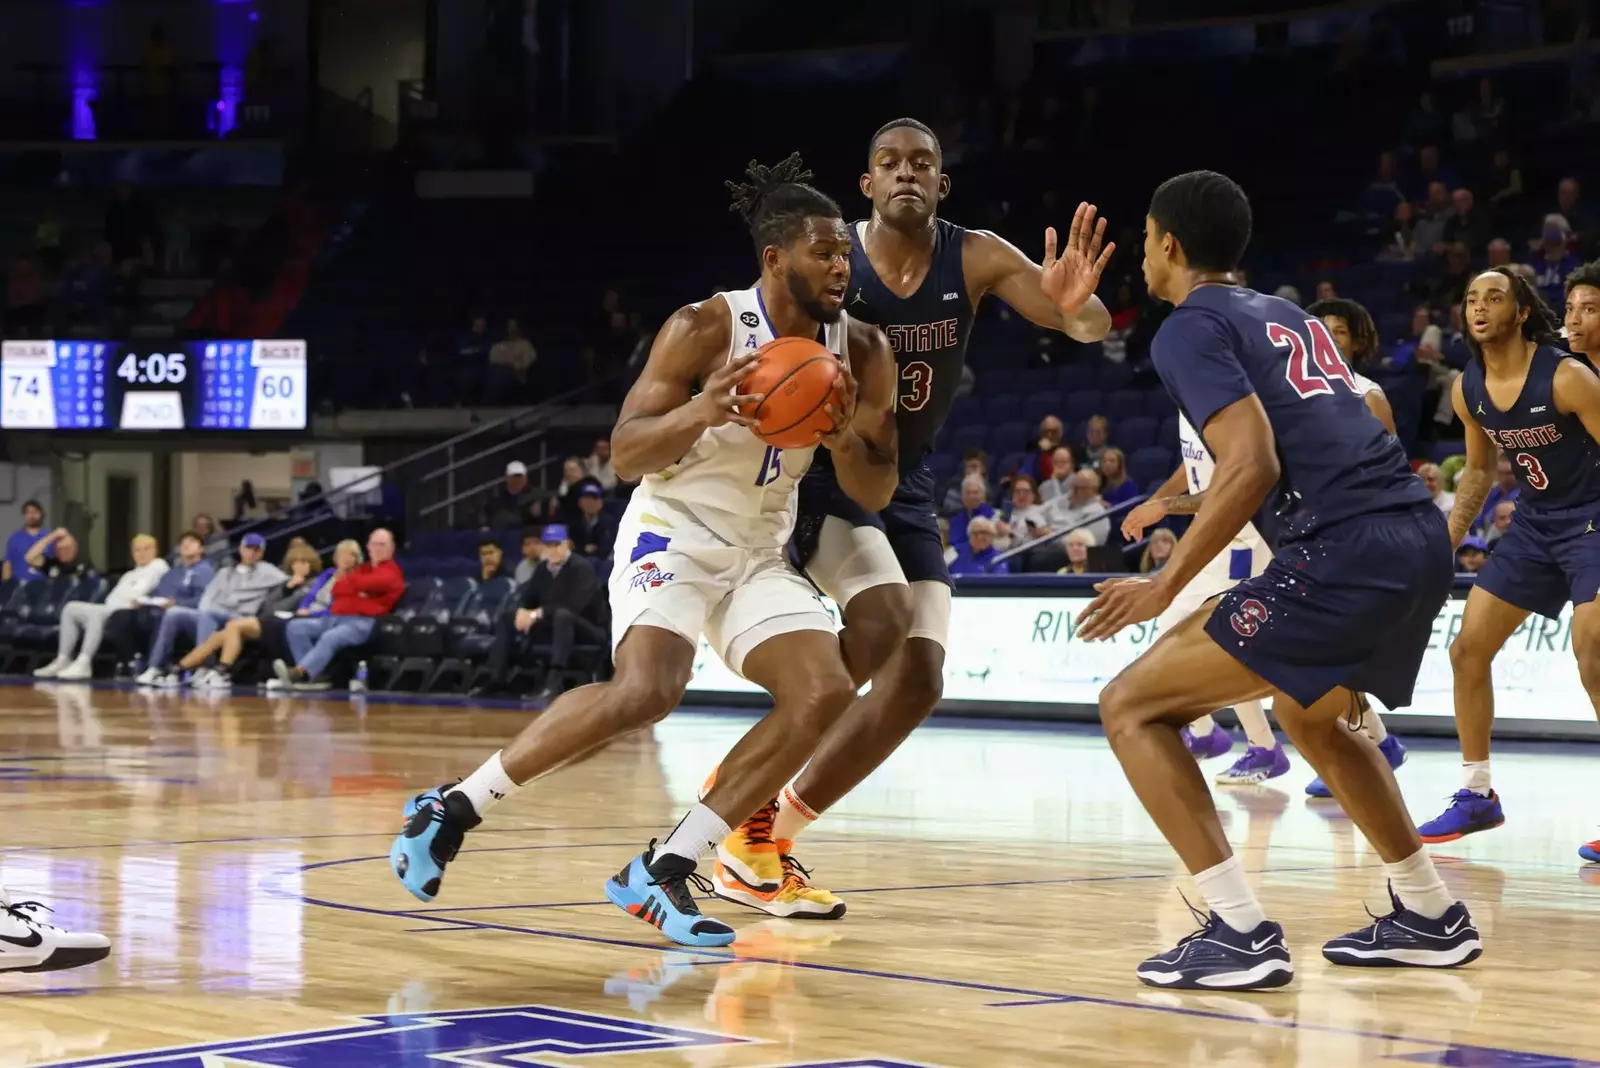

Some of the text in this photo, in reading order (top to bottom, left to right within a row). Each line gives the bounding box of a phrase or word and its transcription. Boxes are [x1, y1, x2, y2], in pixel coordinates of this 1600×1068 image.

[742, 315, 758, 326] 32
[886, 318, 958, 353] STATE
[116, 352, 187, 384] 4:05
[1265, 319, 1363, 400] 24
[8, 375, 41, 399] 74
[262, 375, 294, 399] 60
[1499, 423, 1563, 449] STATE
[754, 445, 783, 487] 15
[1516, 452, 1549, 490] 3
[626, 568, 676, 596] Tulsa
